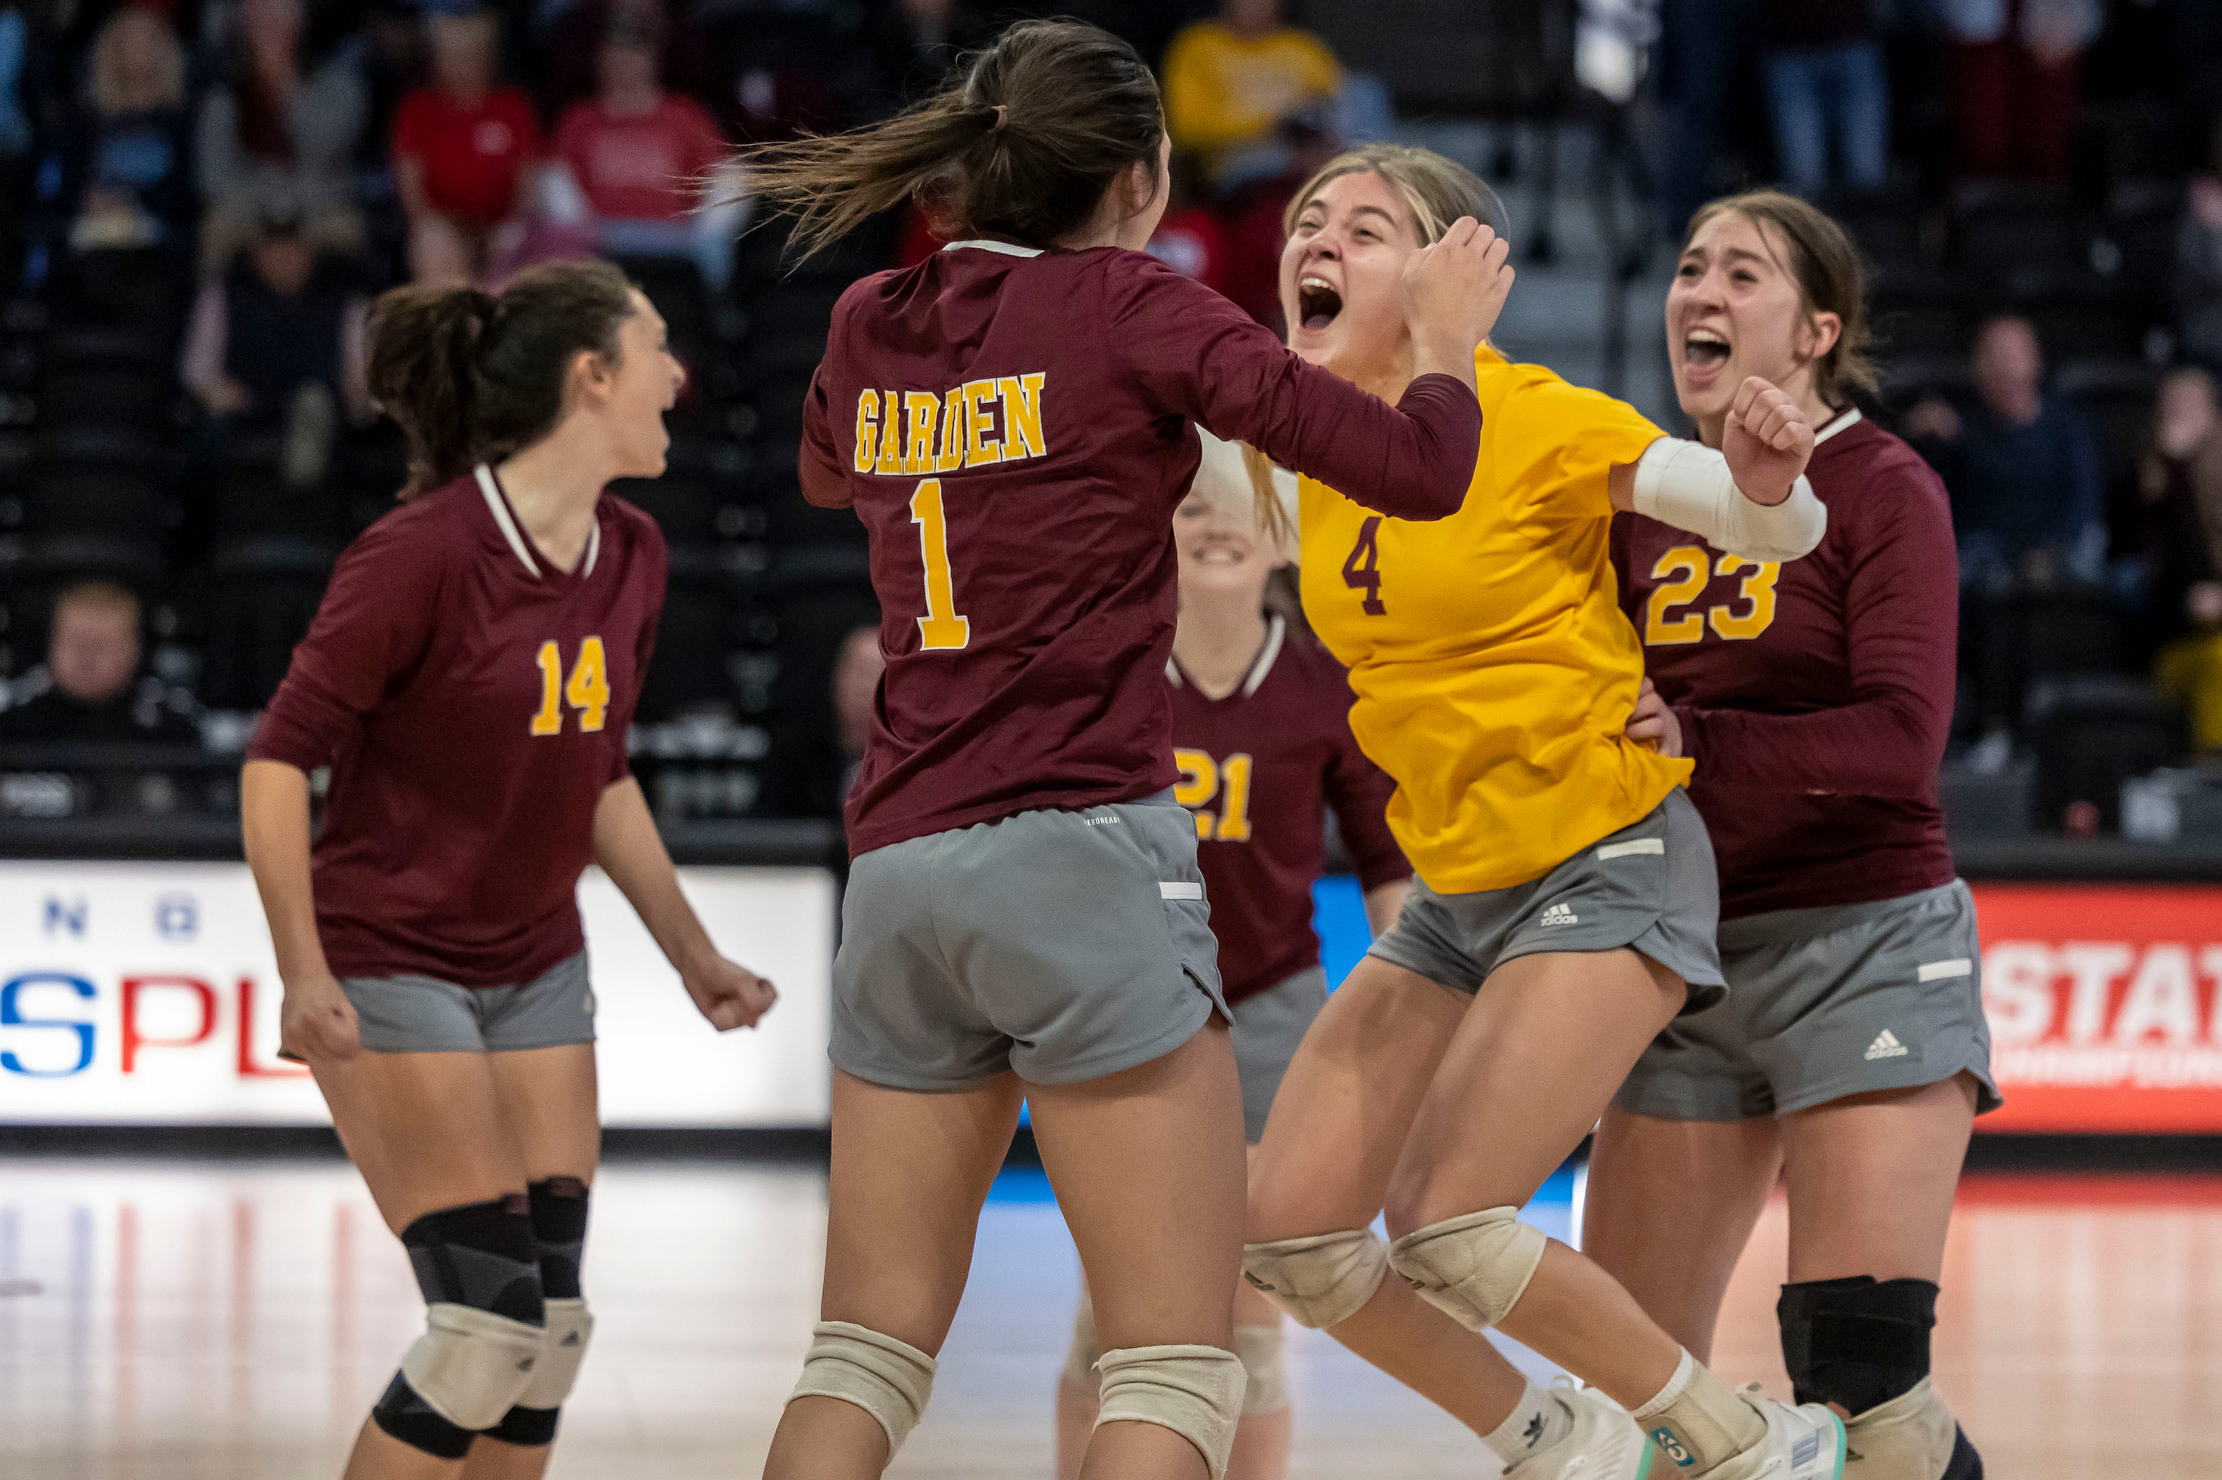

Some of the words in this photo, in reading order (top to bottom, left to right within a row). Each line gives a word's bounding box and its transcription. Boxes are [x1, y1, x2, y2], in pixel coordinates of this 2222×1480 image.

[855, 372, 1047, 475] GARDEN
[910, 478, 970, 650] 1
[1342, 516, 1387, 615] 4
[1645, 545, 1782, 646] 23
[530, 636, 610, 735] 14
[1173, 748, 1252, 841] 21
